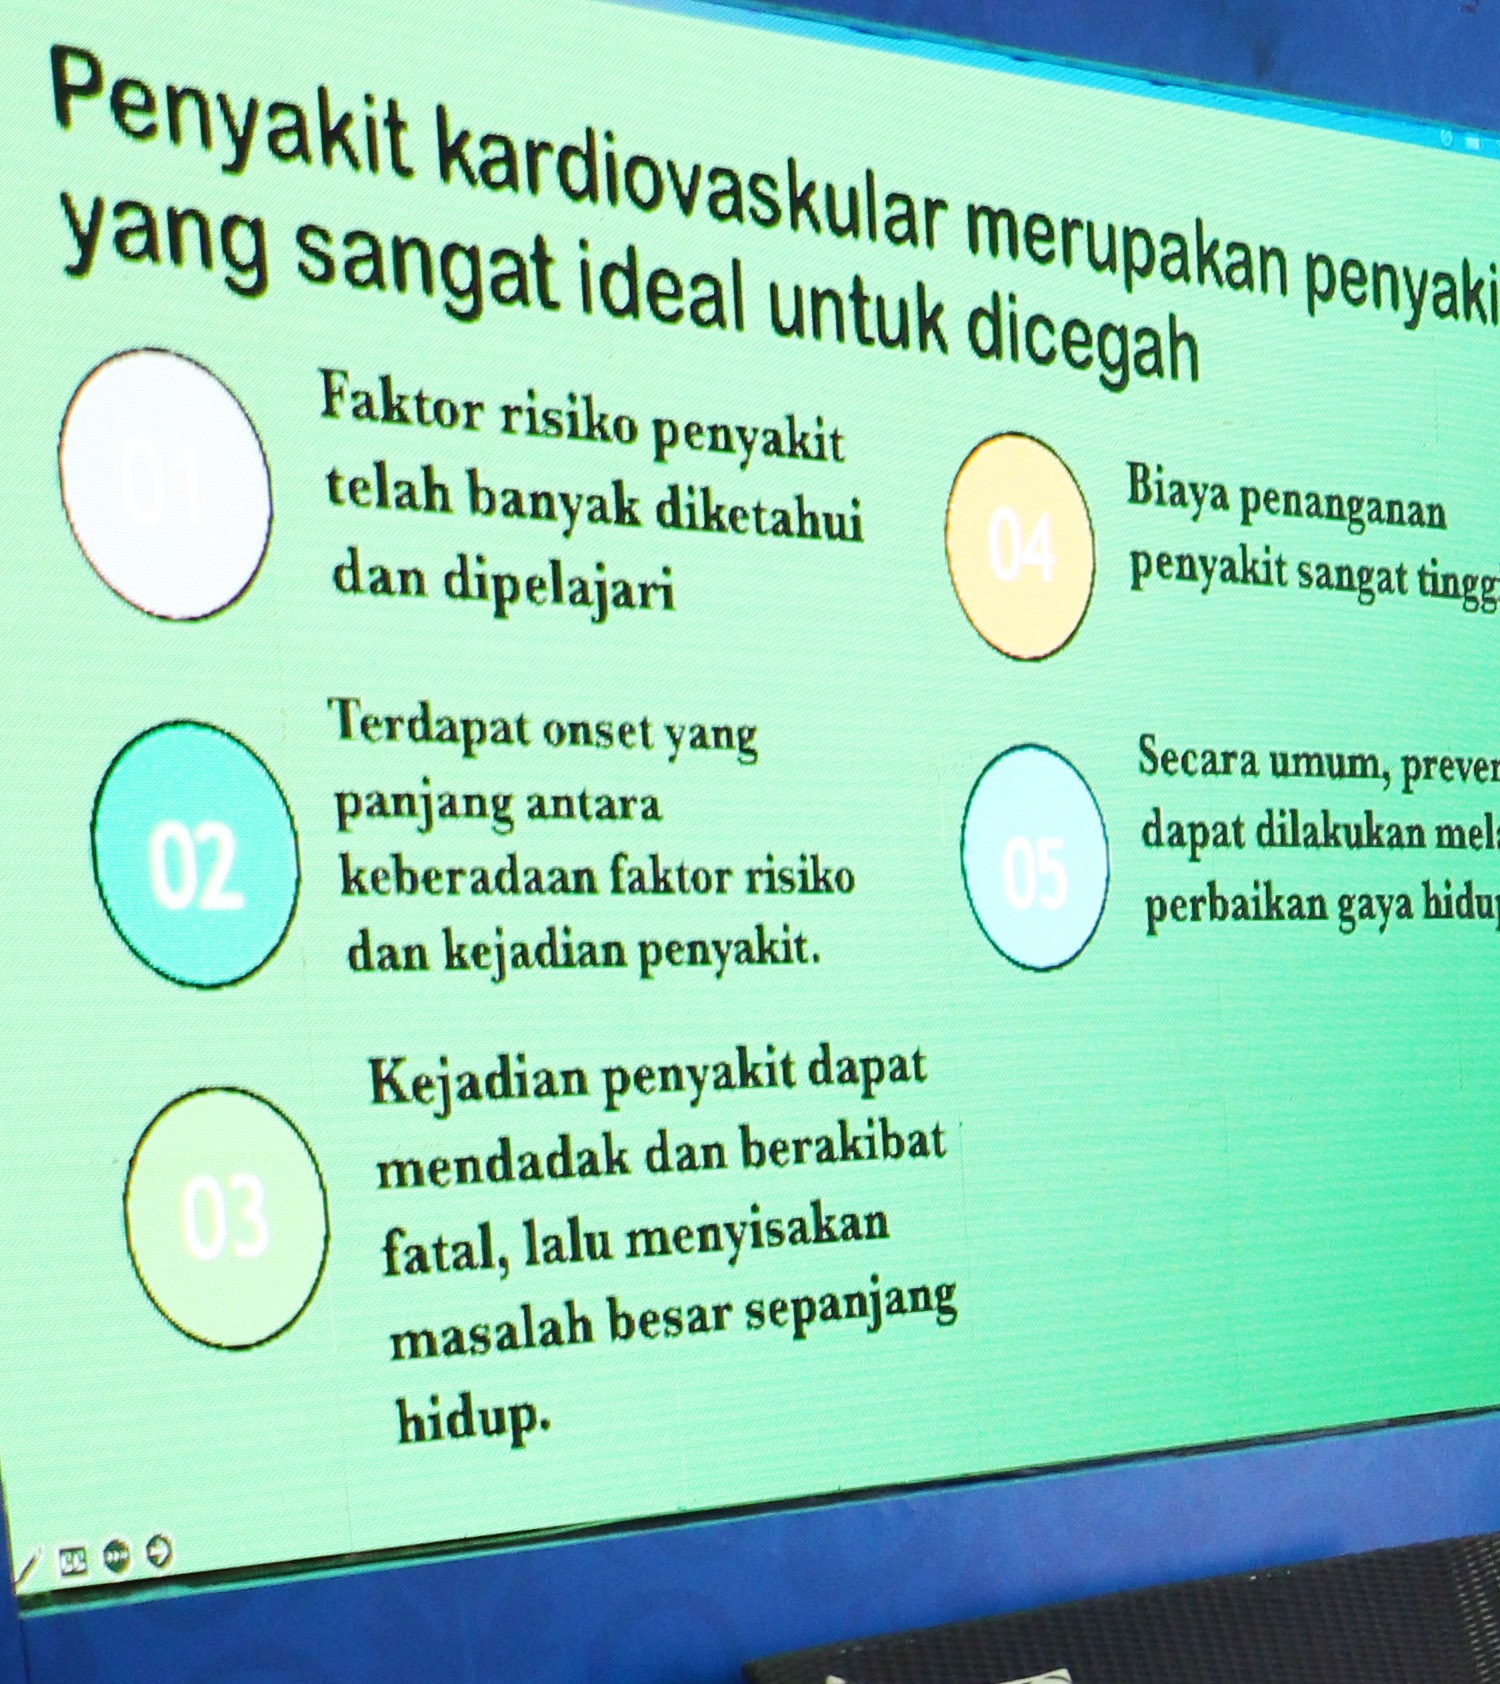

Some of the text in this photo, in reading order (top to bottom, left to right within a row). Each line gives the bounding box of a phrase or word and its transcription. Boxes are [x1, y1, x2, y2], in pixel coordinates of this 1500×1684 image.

[51, 45, 413, 178] Penyakit
[436, 105, 947, 249] kardiovaskular
[968, 204, 1286, 303] merupakan
[60, 192, 1198, 392] yang sangat ideal untuk dicegah
[321, 369, 843, 469] Faktor risiko penyakit
[118, 437, 204, 528] 01
[327, 461, 862, 541] telah banyak diketahui
[1128, 462, 1446, 534] Biaya penanganan
[987, 506, 1056, 584] 04
[1131, 544, 1286, 593] penyakit
[1298, 563, 1406, 604] sangat
[334, 547, 672, 623] dan dipelajari
[328, 699, 757, 763] Terdapat onset yang
[1140, 734, 1258, 776] Secara
[1270, 753, 1390, 789] umum,
[335, 777, 660, 833] panjang antara
[1143, 808, 1244, 862] dapat
[1257, 809, 1425, 849] dilakukan
[148, 821, 245, 912] 02
[340, 853, 854, 894] keberadaan faktor risiko
[1003, 836, 1069, 911] 05
[1146, 880, 1327, 935] perbaikan
[1338, 894, 1413, 934] gaya
[348, 924, 818, 982] dan kejadian penyakit.
[369, 1043, 925, 1119] Kejadian penyakit dapat
[377, 1117, 945, 1188] mendadak dan berakibat
[180, 1173, 271, 1262] 03
[383, 1200, 888, 1278] fatal, lalu menyisakan
[391, 1274, 957, 1360] masalah besar sepanjang
[396, 1392, 549, 1448] hidup.
